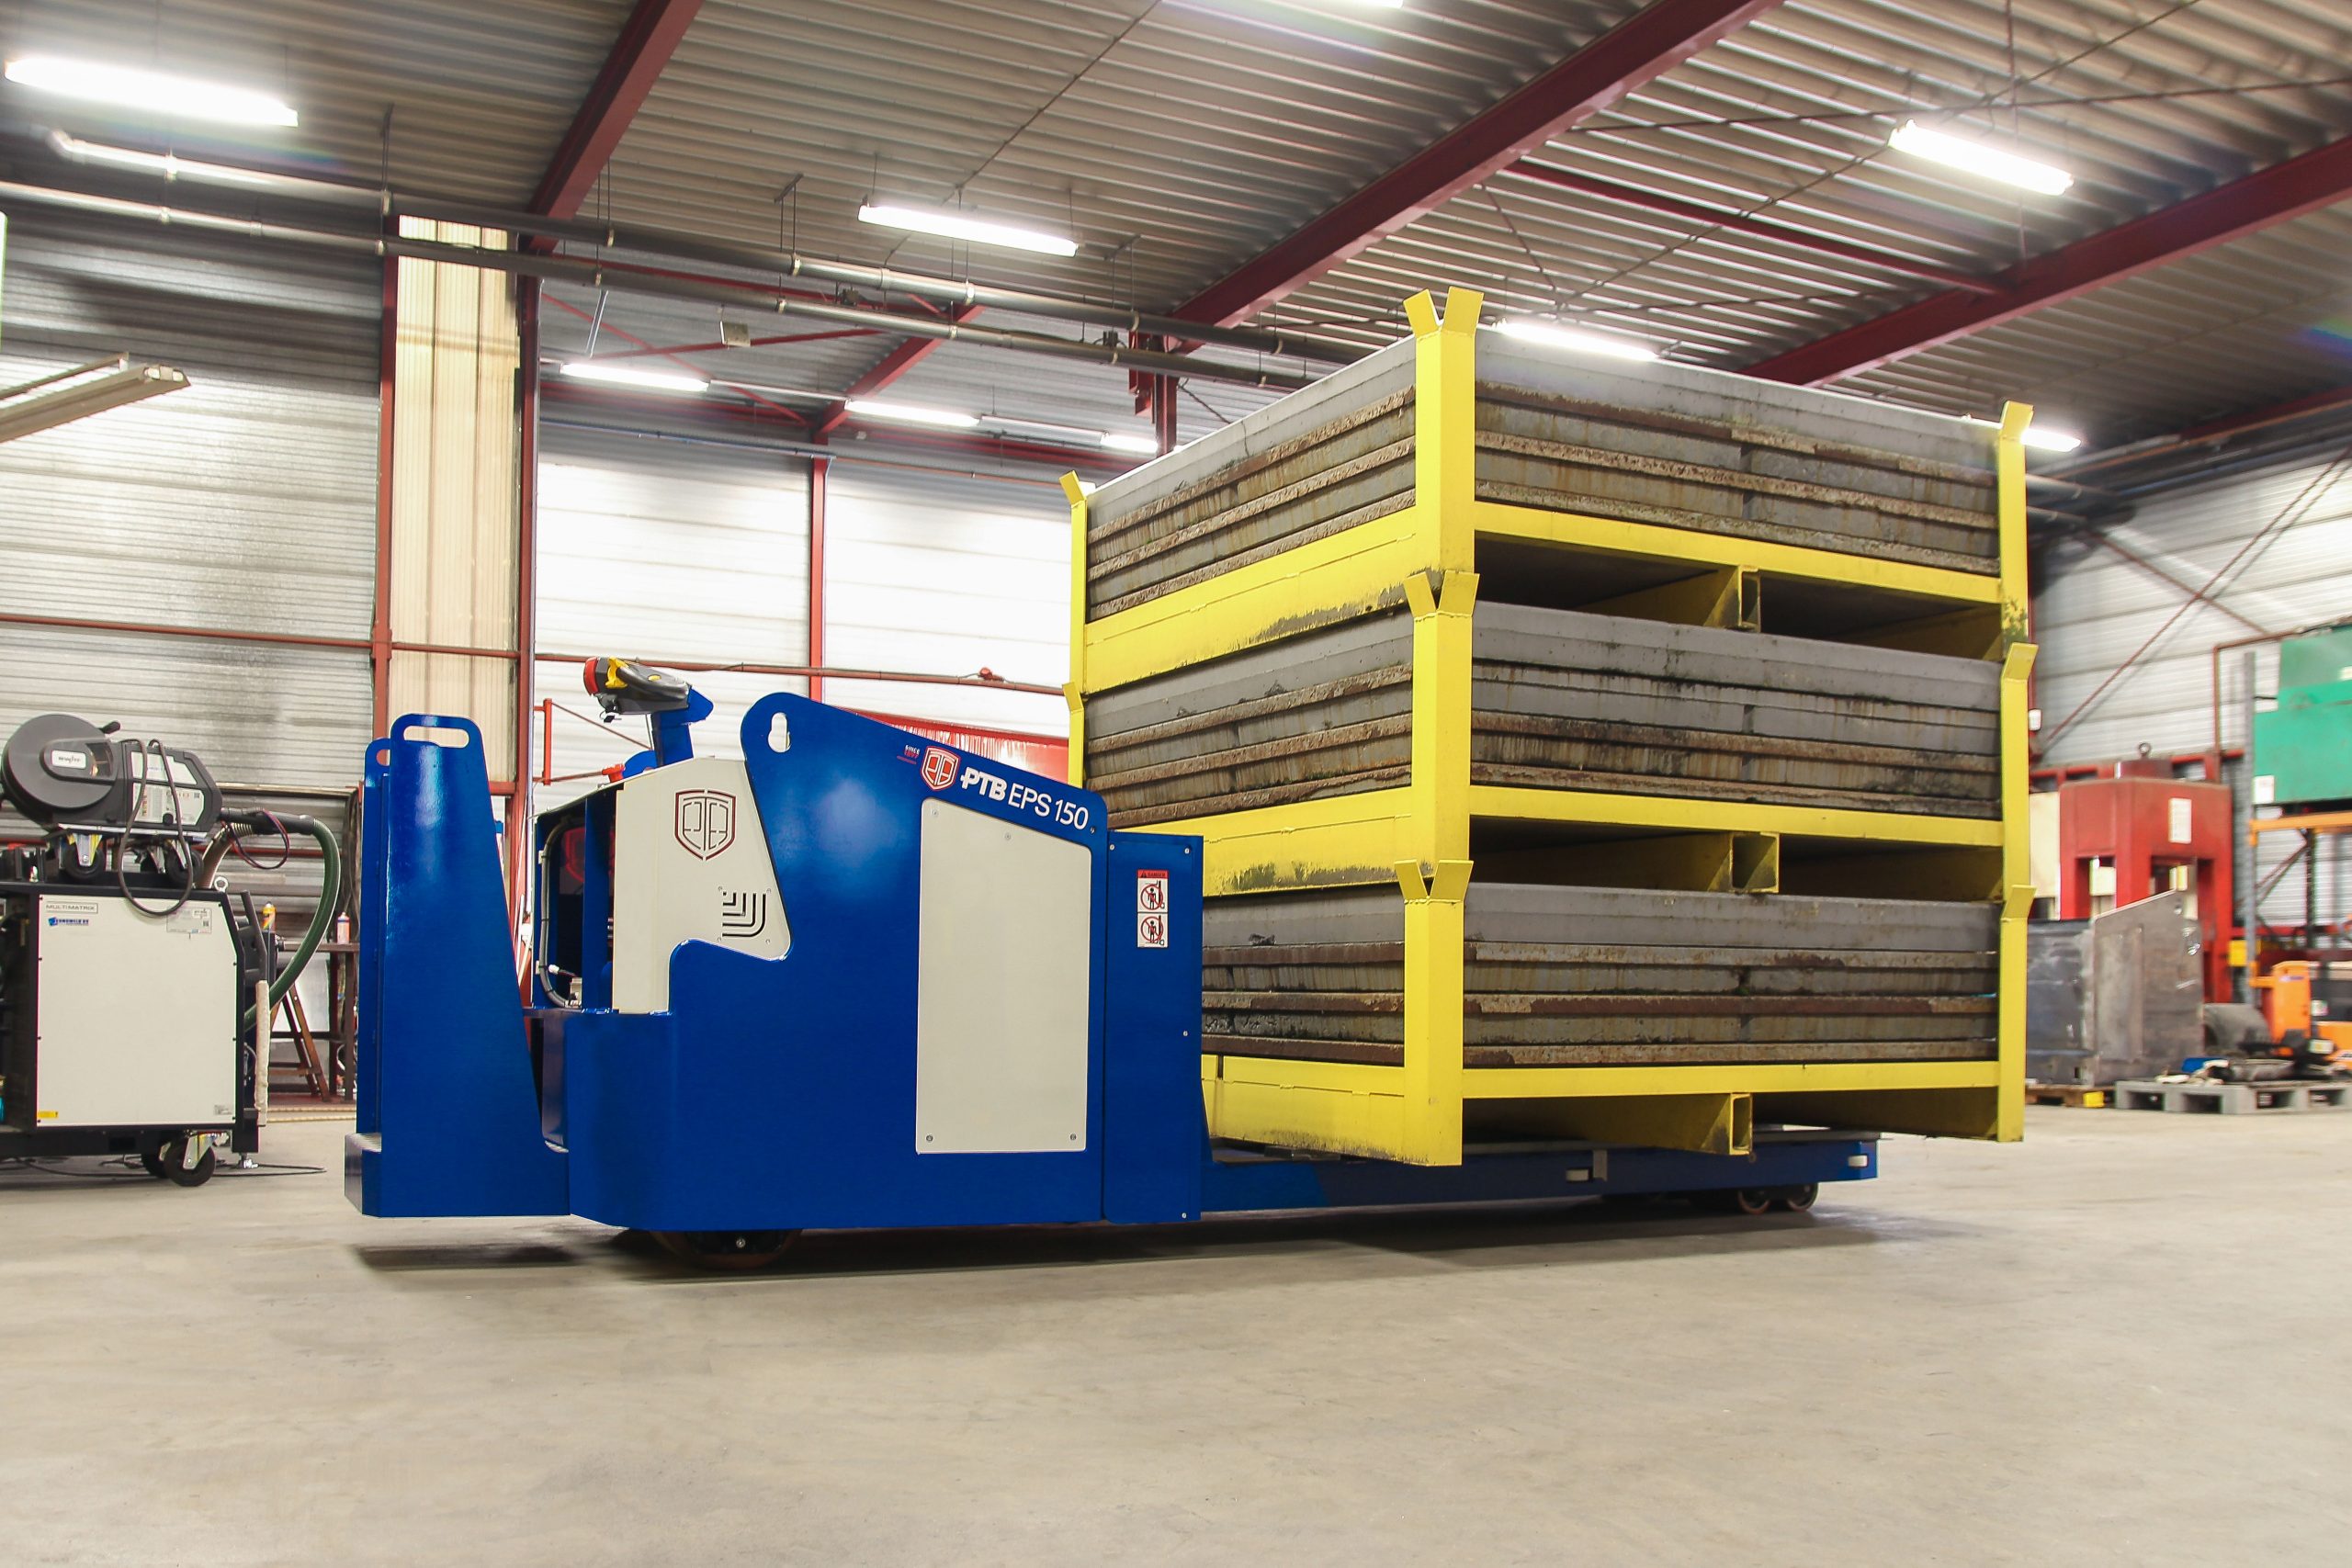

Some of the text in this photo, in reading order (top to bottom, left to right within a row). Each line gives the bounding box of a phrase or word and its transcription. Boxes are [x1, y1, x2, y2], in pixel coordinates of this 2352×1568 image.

[960, 766, 1089, 830] PTB EPS 150
